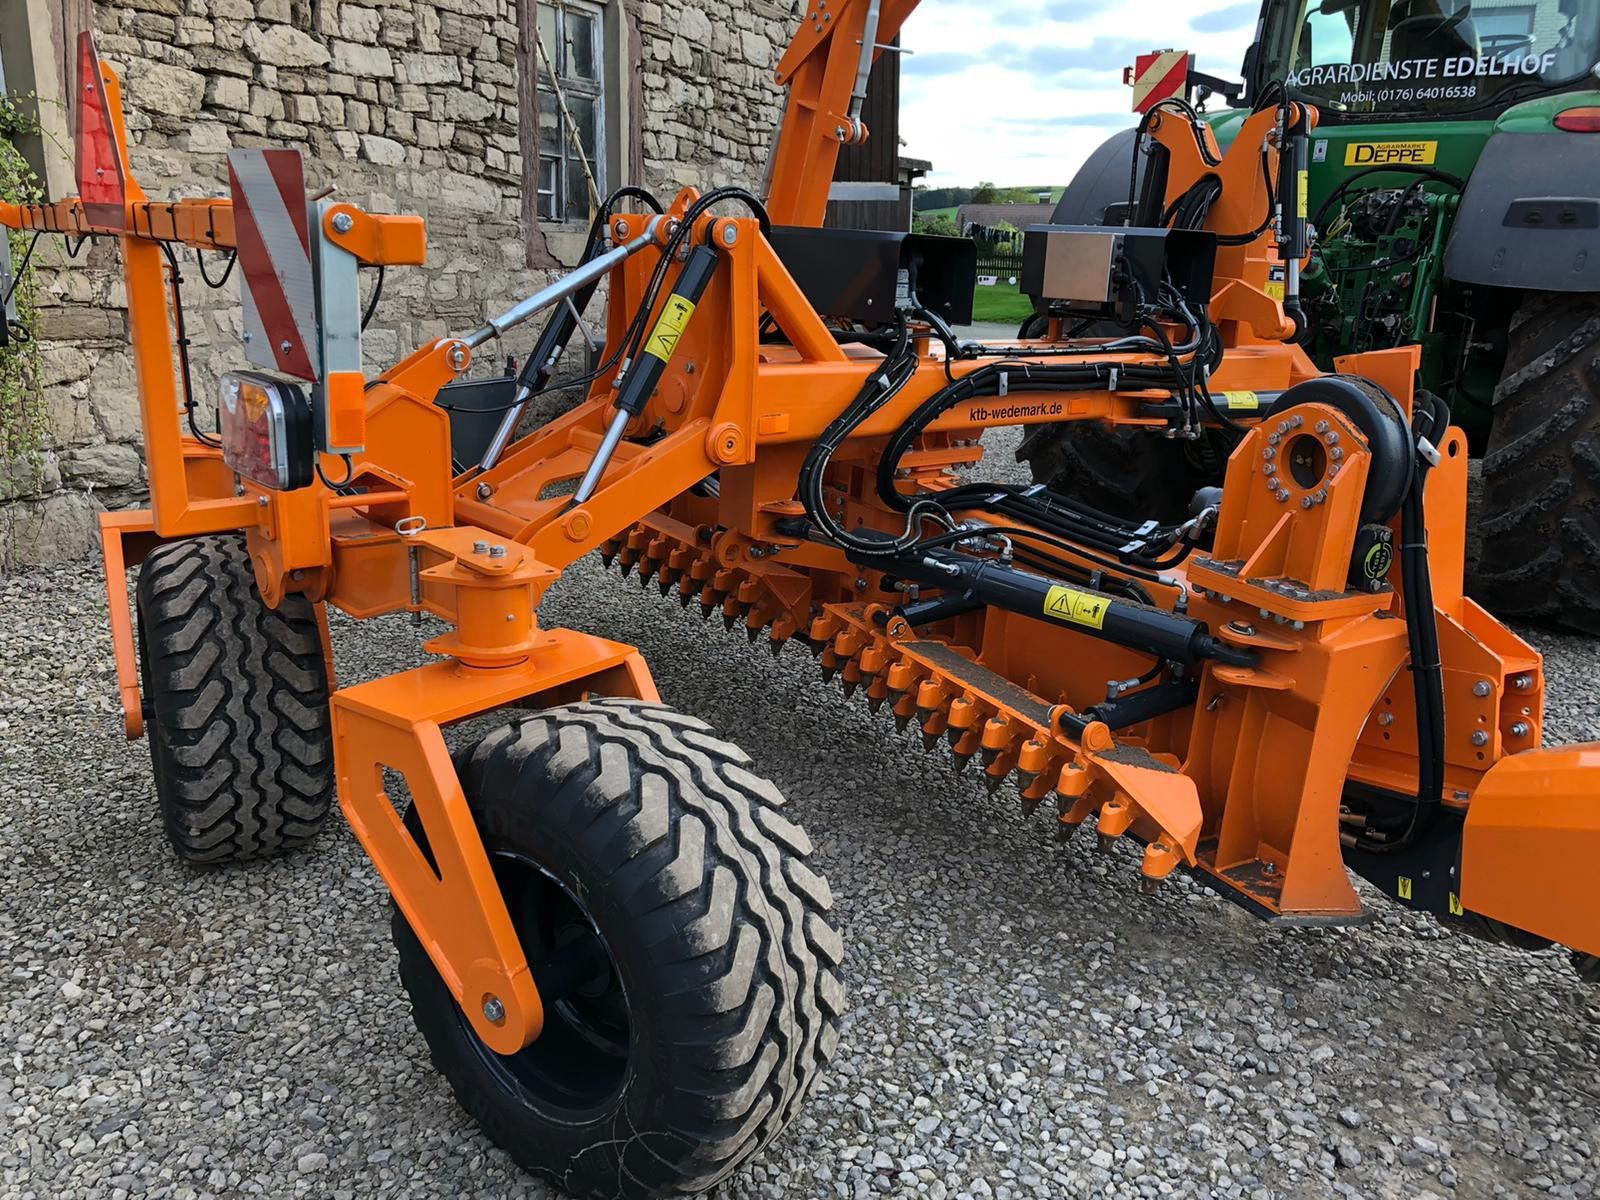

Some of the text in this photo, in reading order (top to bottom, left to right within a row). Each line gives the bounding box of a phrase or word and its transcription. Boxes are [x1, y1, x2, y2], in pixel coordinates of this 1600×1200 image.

[1284, 53, 1557, 87] AGRARDIENSTE EDELHOF
[1340, 86, 1477, 103] Mobil: (0176) 64016538
[1354, 144, 1426, 163] DEPPE
[970, 402, 1062, 421] ktb-wedemark.de
